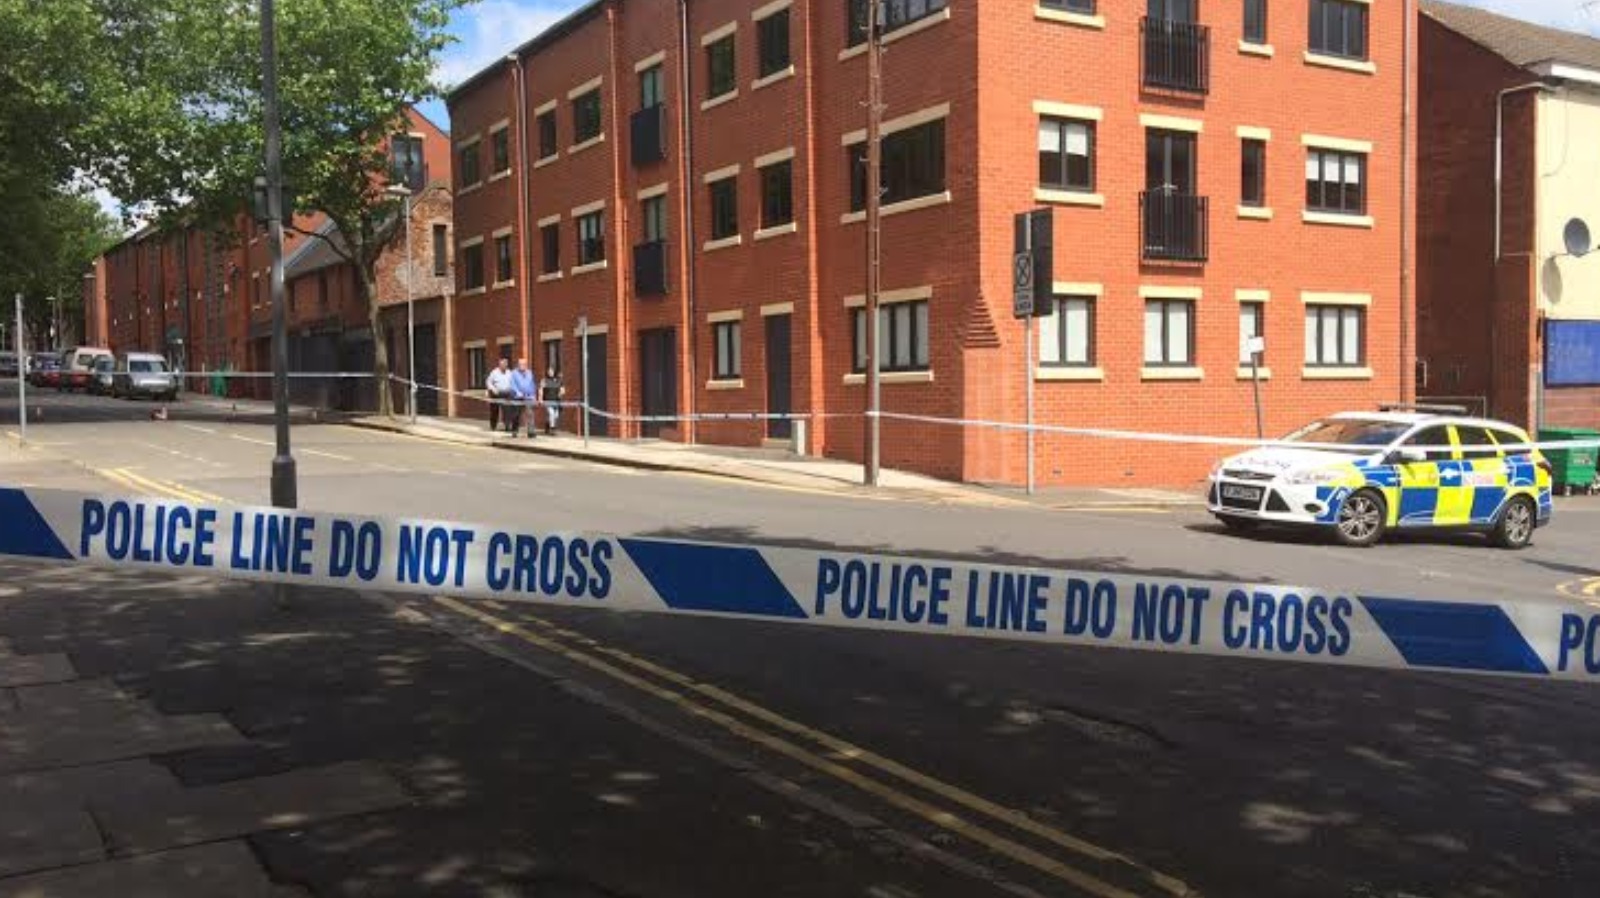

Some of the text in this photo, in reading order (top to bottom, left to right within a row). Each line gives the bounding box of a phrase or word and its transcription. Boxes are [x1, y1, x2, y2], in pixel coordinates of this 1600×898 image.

[80, 498, 613, 600] POLICE LINE DO NOT CROSS
[815, 557, 1354, 657] POLICE LINE DO NOT CROSS
